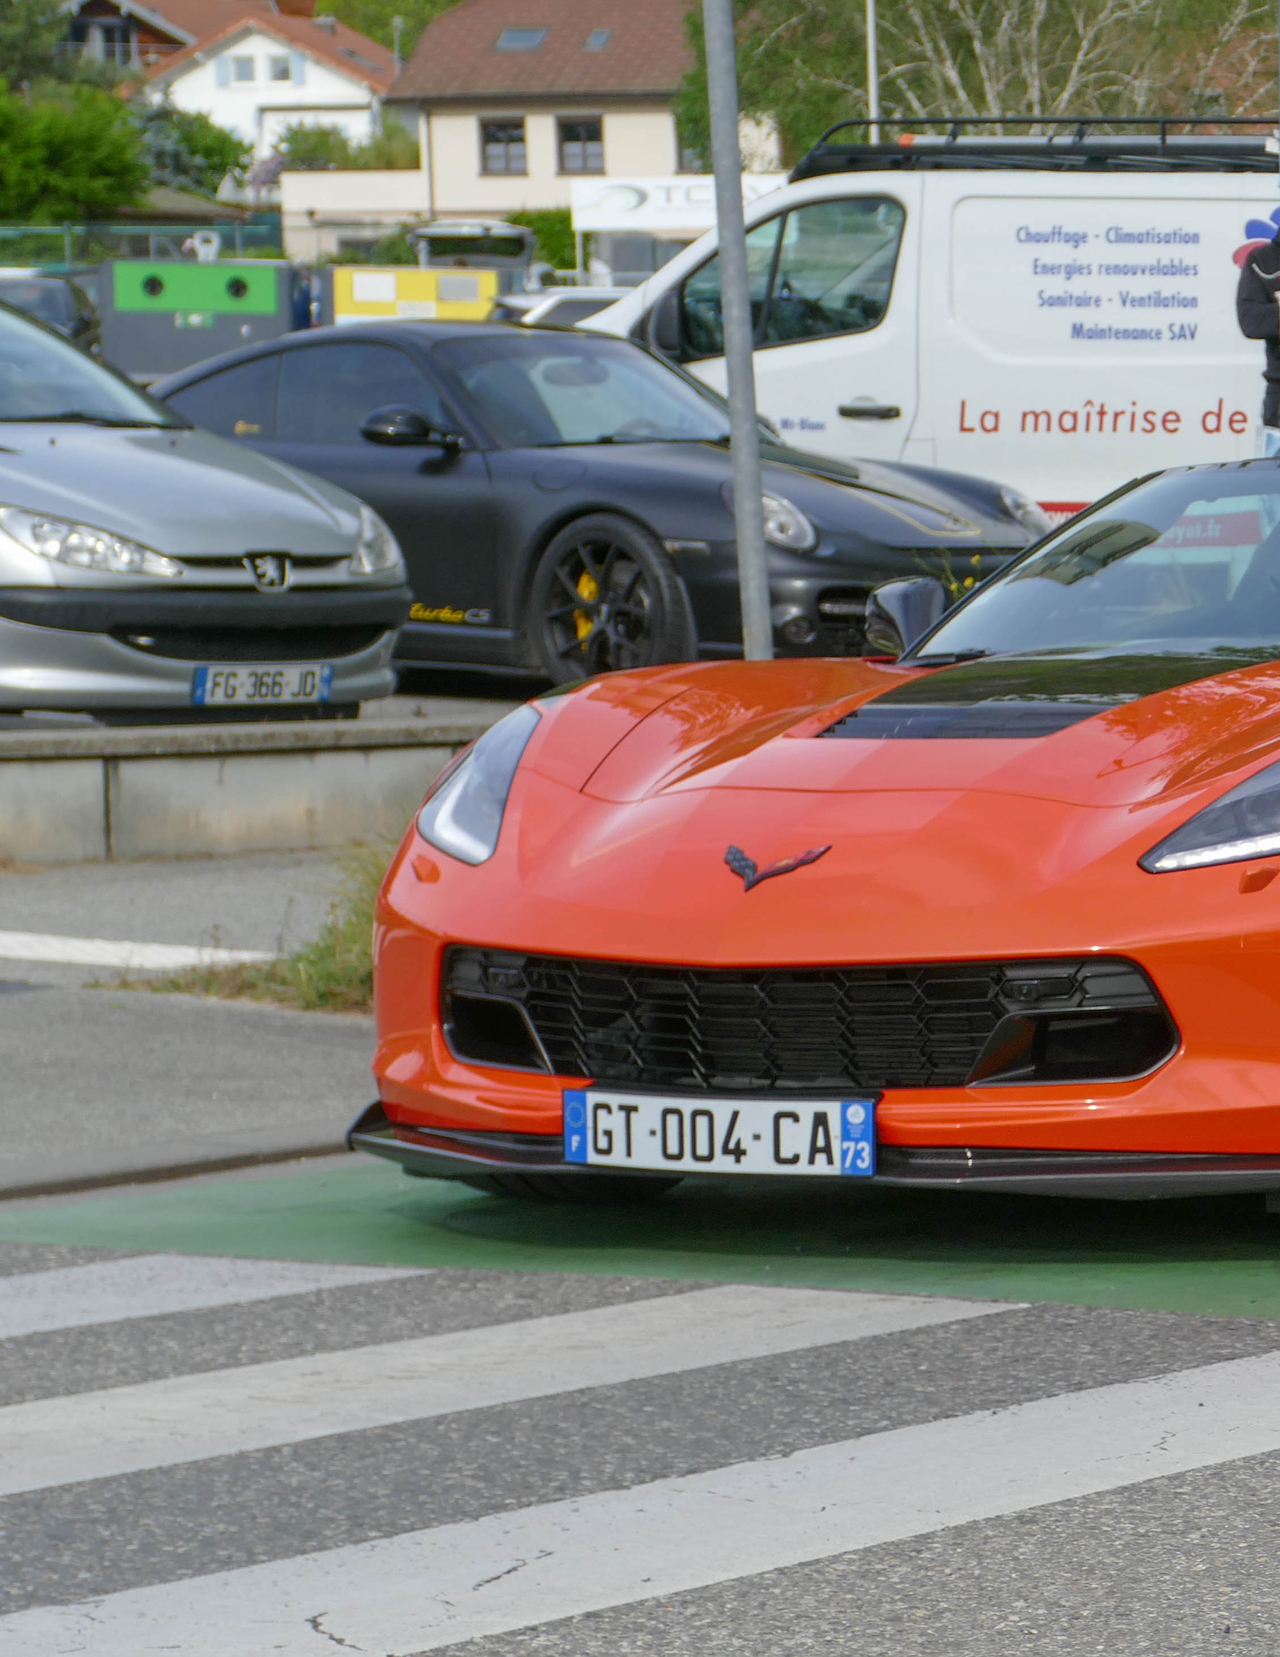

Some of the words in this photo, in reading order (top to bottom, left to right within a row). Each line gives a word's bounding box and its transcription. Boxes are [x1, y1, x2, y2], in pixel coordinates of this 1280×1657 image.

[1016, 225, 1089, 249] Chauffage
[1105, 226, 1200, 244] Climatisation
[1032, 258, 1092, 280] Energies
[1098, 258, 1199, 277] renouvelables
[1038, 290, 1101, 308] Sanitaire
[1119, 290, 1199, 308] Ventilation
[1071, 322, 1163, 341] Maintenance
[1168, 322, 1198, 341] SAV
[959, 399, 1000, 433] La
[1021, 399, 1182, 434] maîtrise
[1201, 397, 1248, 434] de
[593, 1102, 834, 1166] GT-004-CA
[842, 1140, 870, 1169] 73
